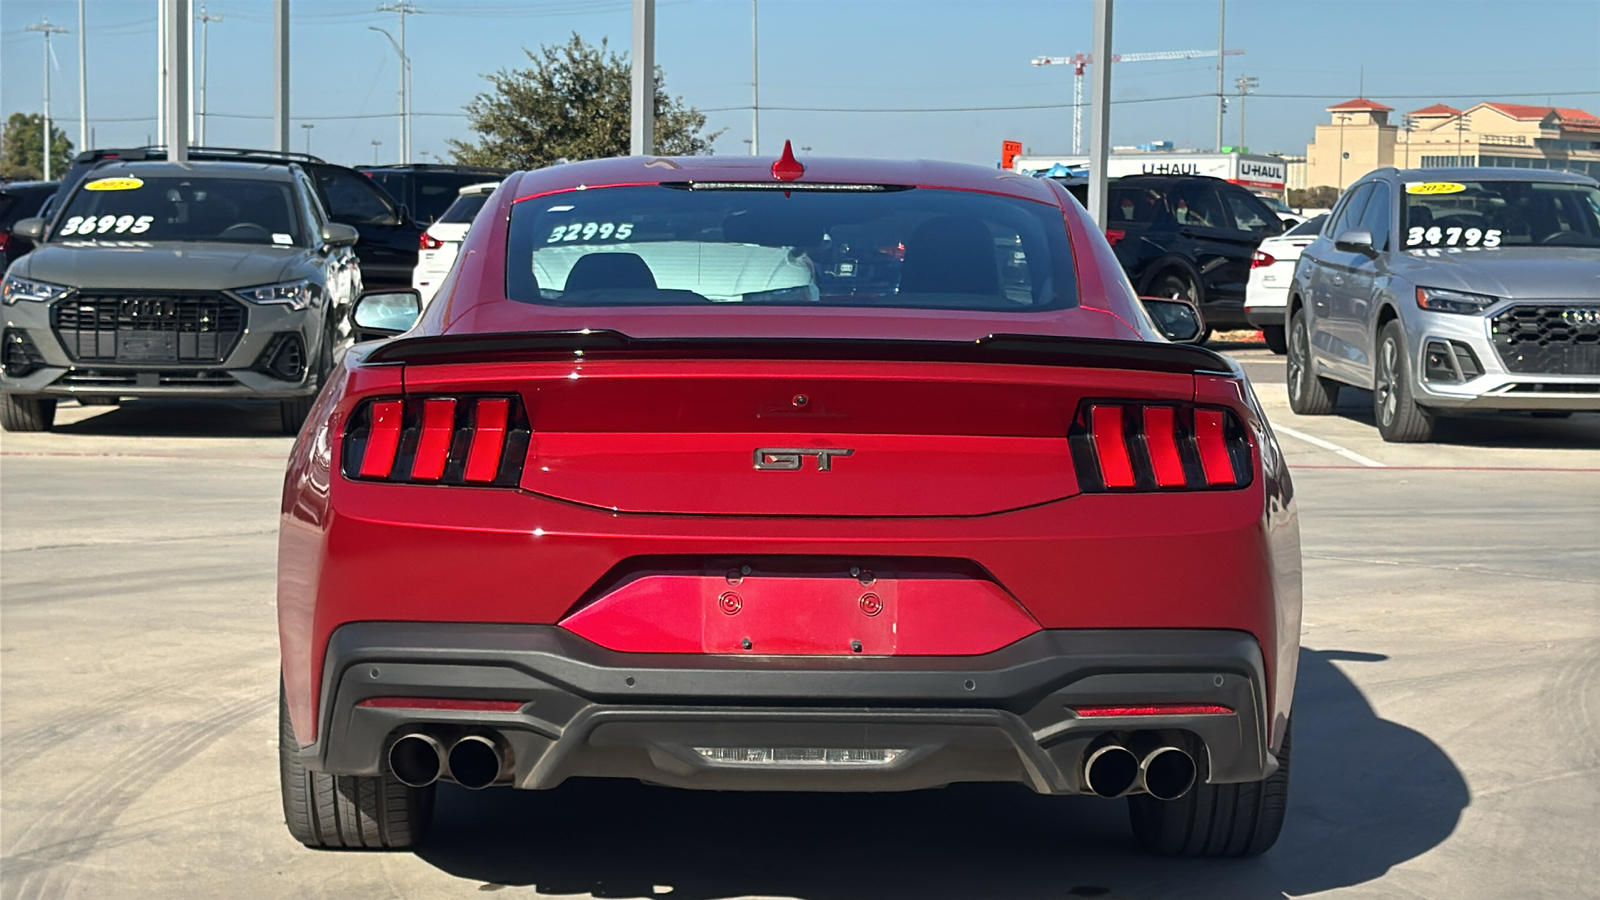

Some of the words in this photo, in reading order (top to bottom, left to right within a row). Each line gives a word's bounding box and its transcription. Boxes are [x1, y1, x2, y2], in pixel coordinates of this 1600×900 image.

[1142, 163, 1200, 175] U-HAUL
[1241, 164, 1282, 179] U-HAUL
[60, 215, 154, 236] 36995
[547, 222, 634, 243] 32995
[1406, 226, 1502, 247] 34795
[753, 447, 855, 472] GT
